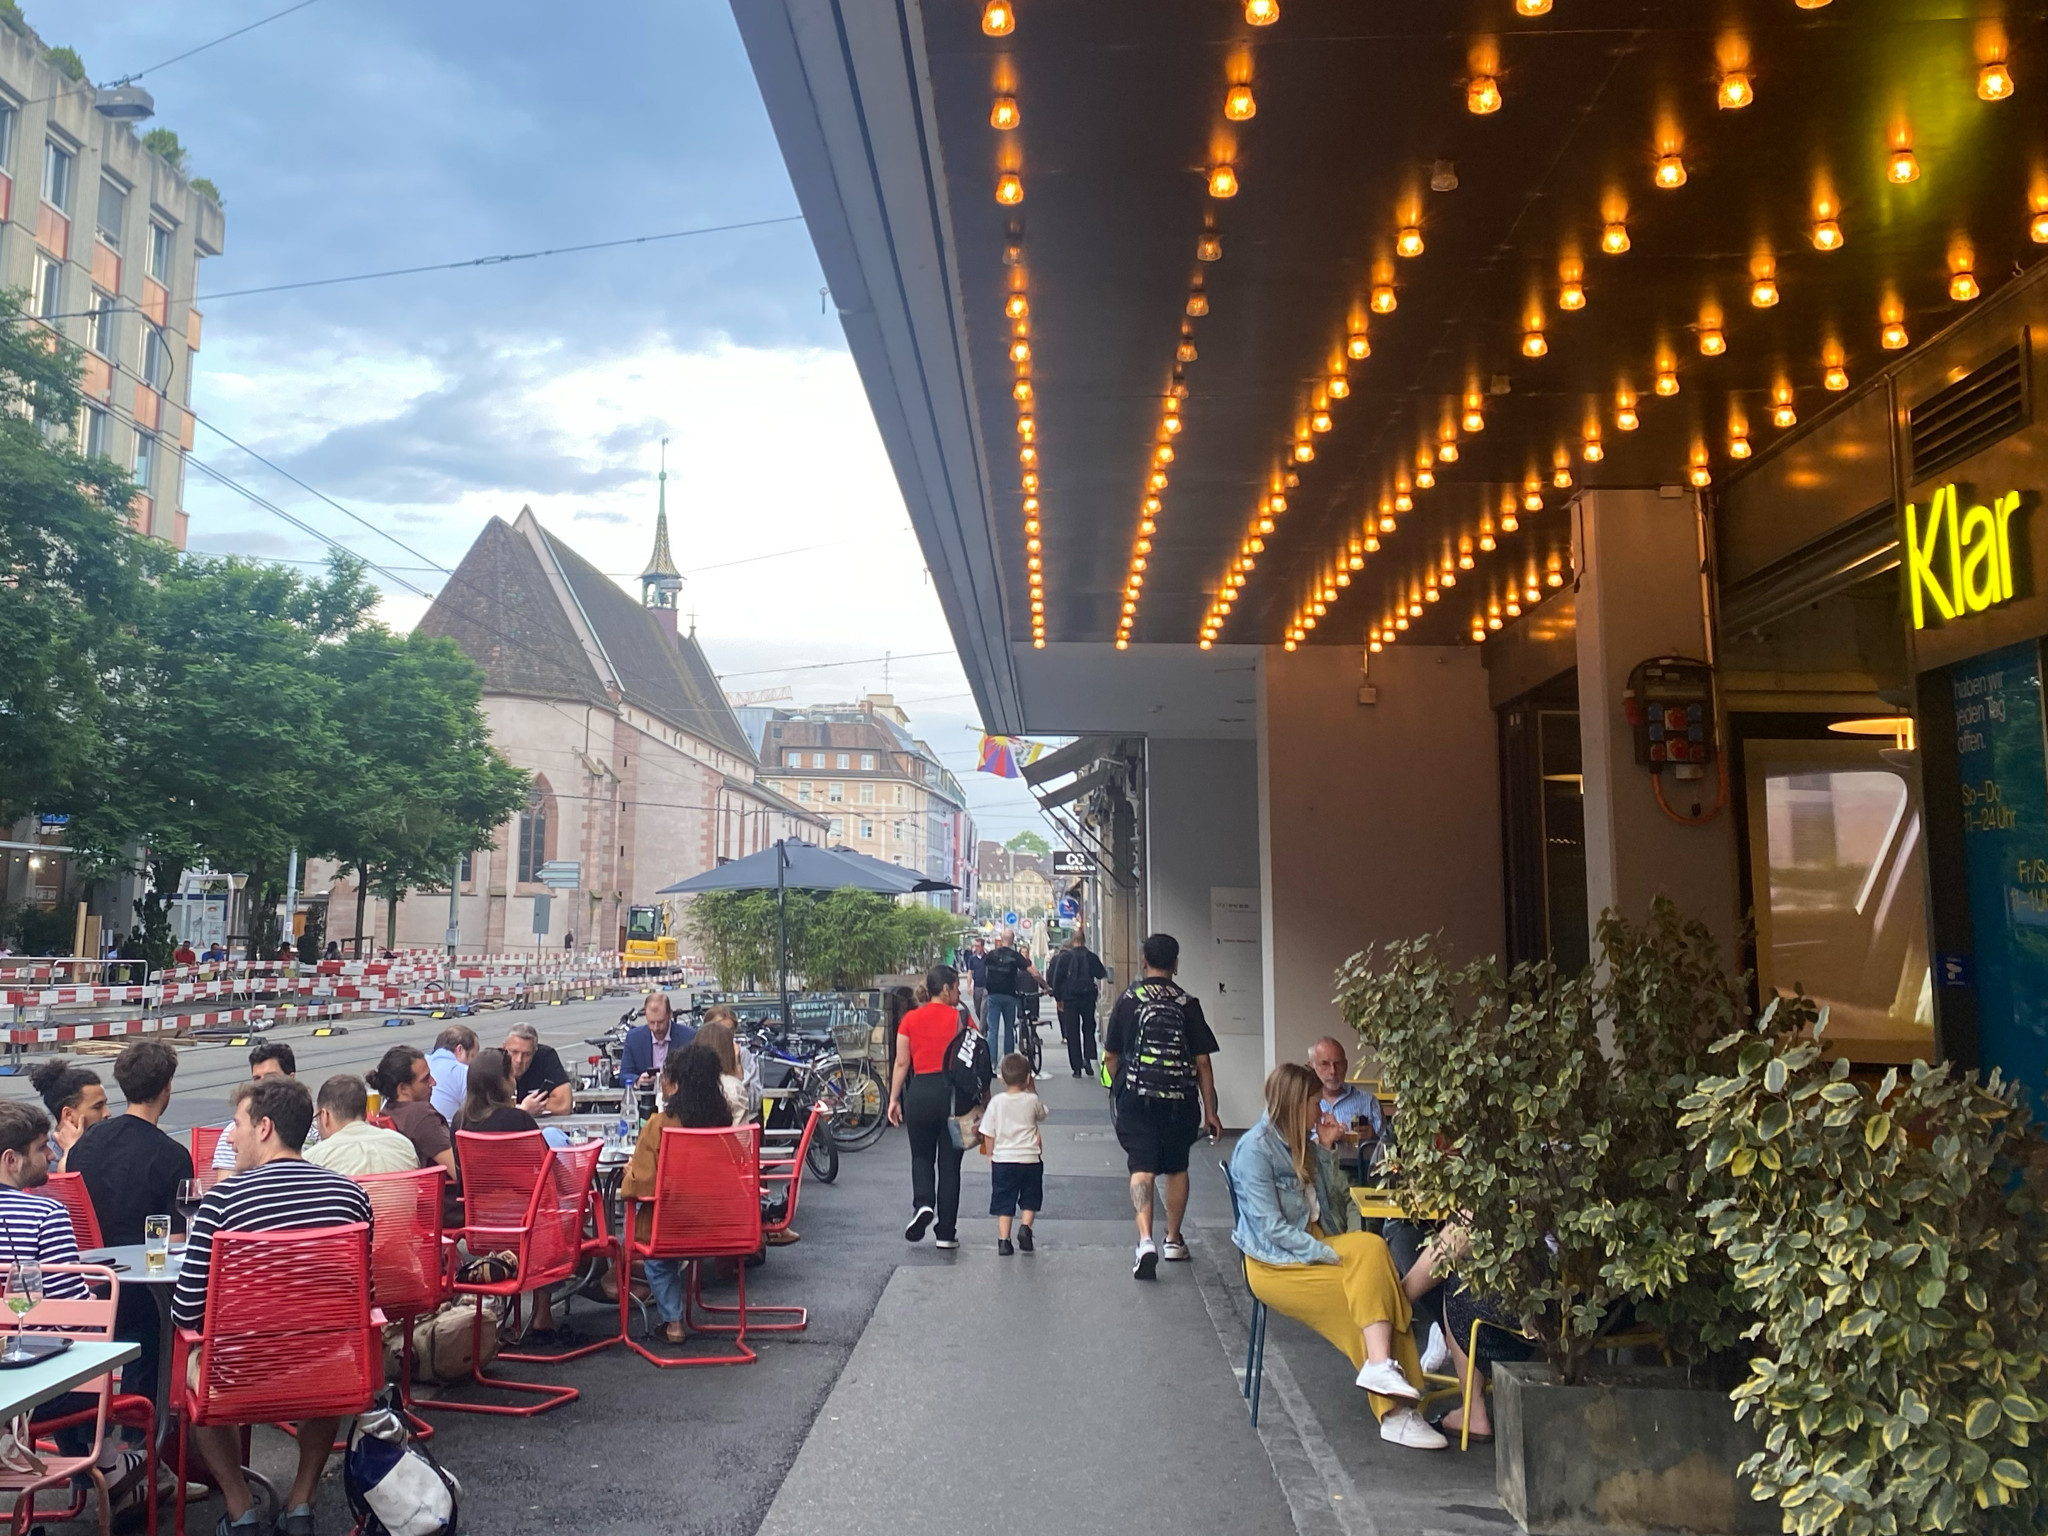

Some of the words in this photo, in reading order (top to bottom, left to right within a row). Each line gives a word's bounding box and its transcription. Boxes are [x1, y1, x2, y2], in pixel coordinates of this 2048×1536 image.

[1905, 483, 2020, 629] Klar
[1954, 675, 1987, 700] haben
[1987, 671, 2004, 691] wir
[1984, 696, 2006, 722] Tag
[1996, 805, 2017, 830] Uhr
[2018, 859, 2048, 884] Fr/S
